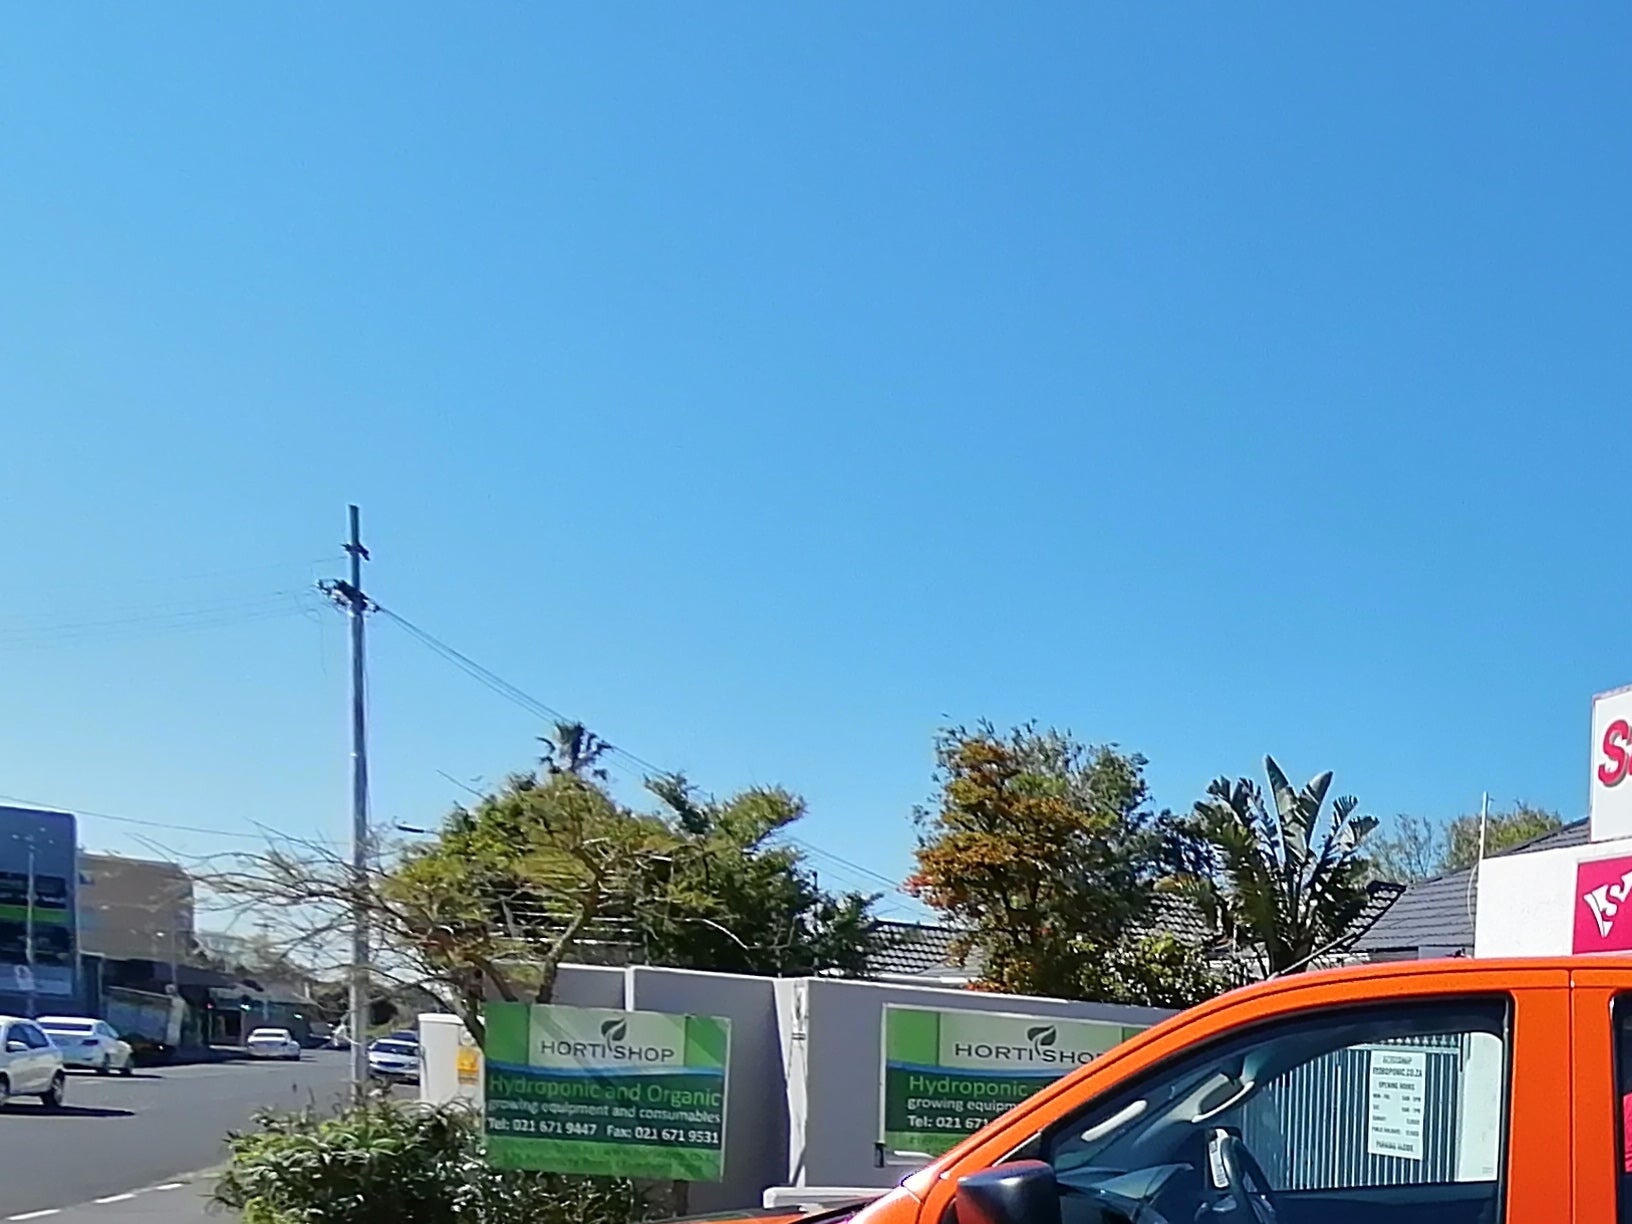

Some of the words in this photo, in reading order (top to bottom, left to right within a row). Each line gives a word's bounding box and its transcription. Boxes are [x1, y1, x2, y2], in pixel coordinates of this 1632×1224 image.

[489, 1074, 601, 1099] Hydroponic
[604, 1083, 641, 1101] and
[647, 1084, 721, 1108] Organic
[909, 1075, 1028, 1097] Hydroponic
[488, 1098, 539, 1115] growing
[541, 1101, 609, 1117] equipment
[612, 1105, 636, 1118] and
[639, 1108, 721, 1123] consumables
[907, 1097, 963, 1112] growing
[487, 1117, 510, 1130] Tel:
[512, 1119, 536, 1132] 021
[539, 1121, 563, 1134] 671
[565, 1122, 597, 1136] 9447
[606, 1124, 631, 1139] Fax:
[634, 1126, 658, 1140] 021
[661, 1128, 686, 1142] 671
[688, 1130, 720, 1144] 9531
[907, 1115, 932, 1128] Tel:
[936, 1116, 961, 1129] 021
